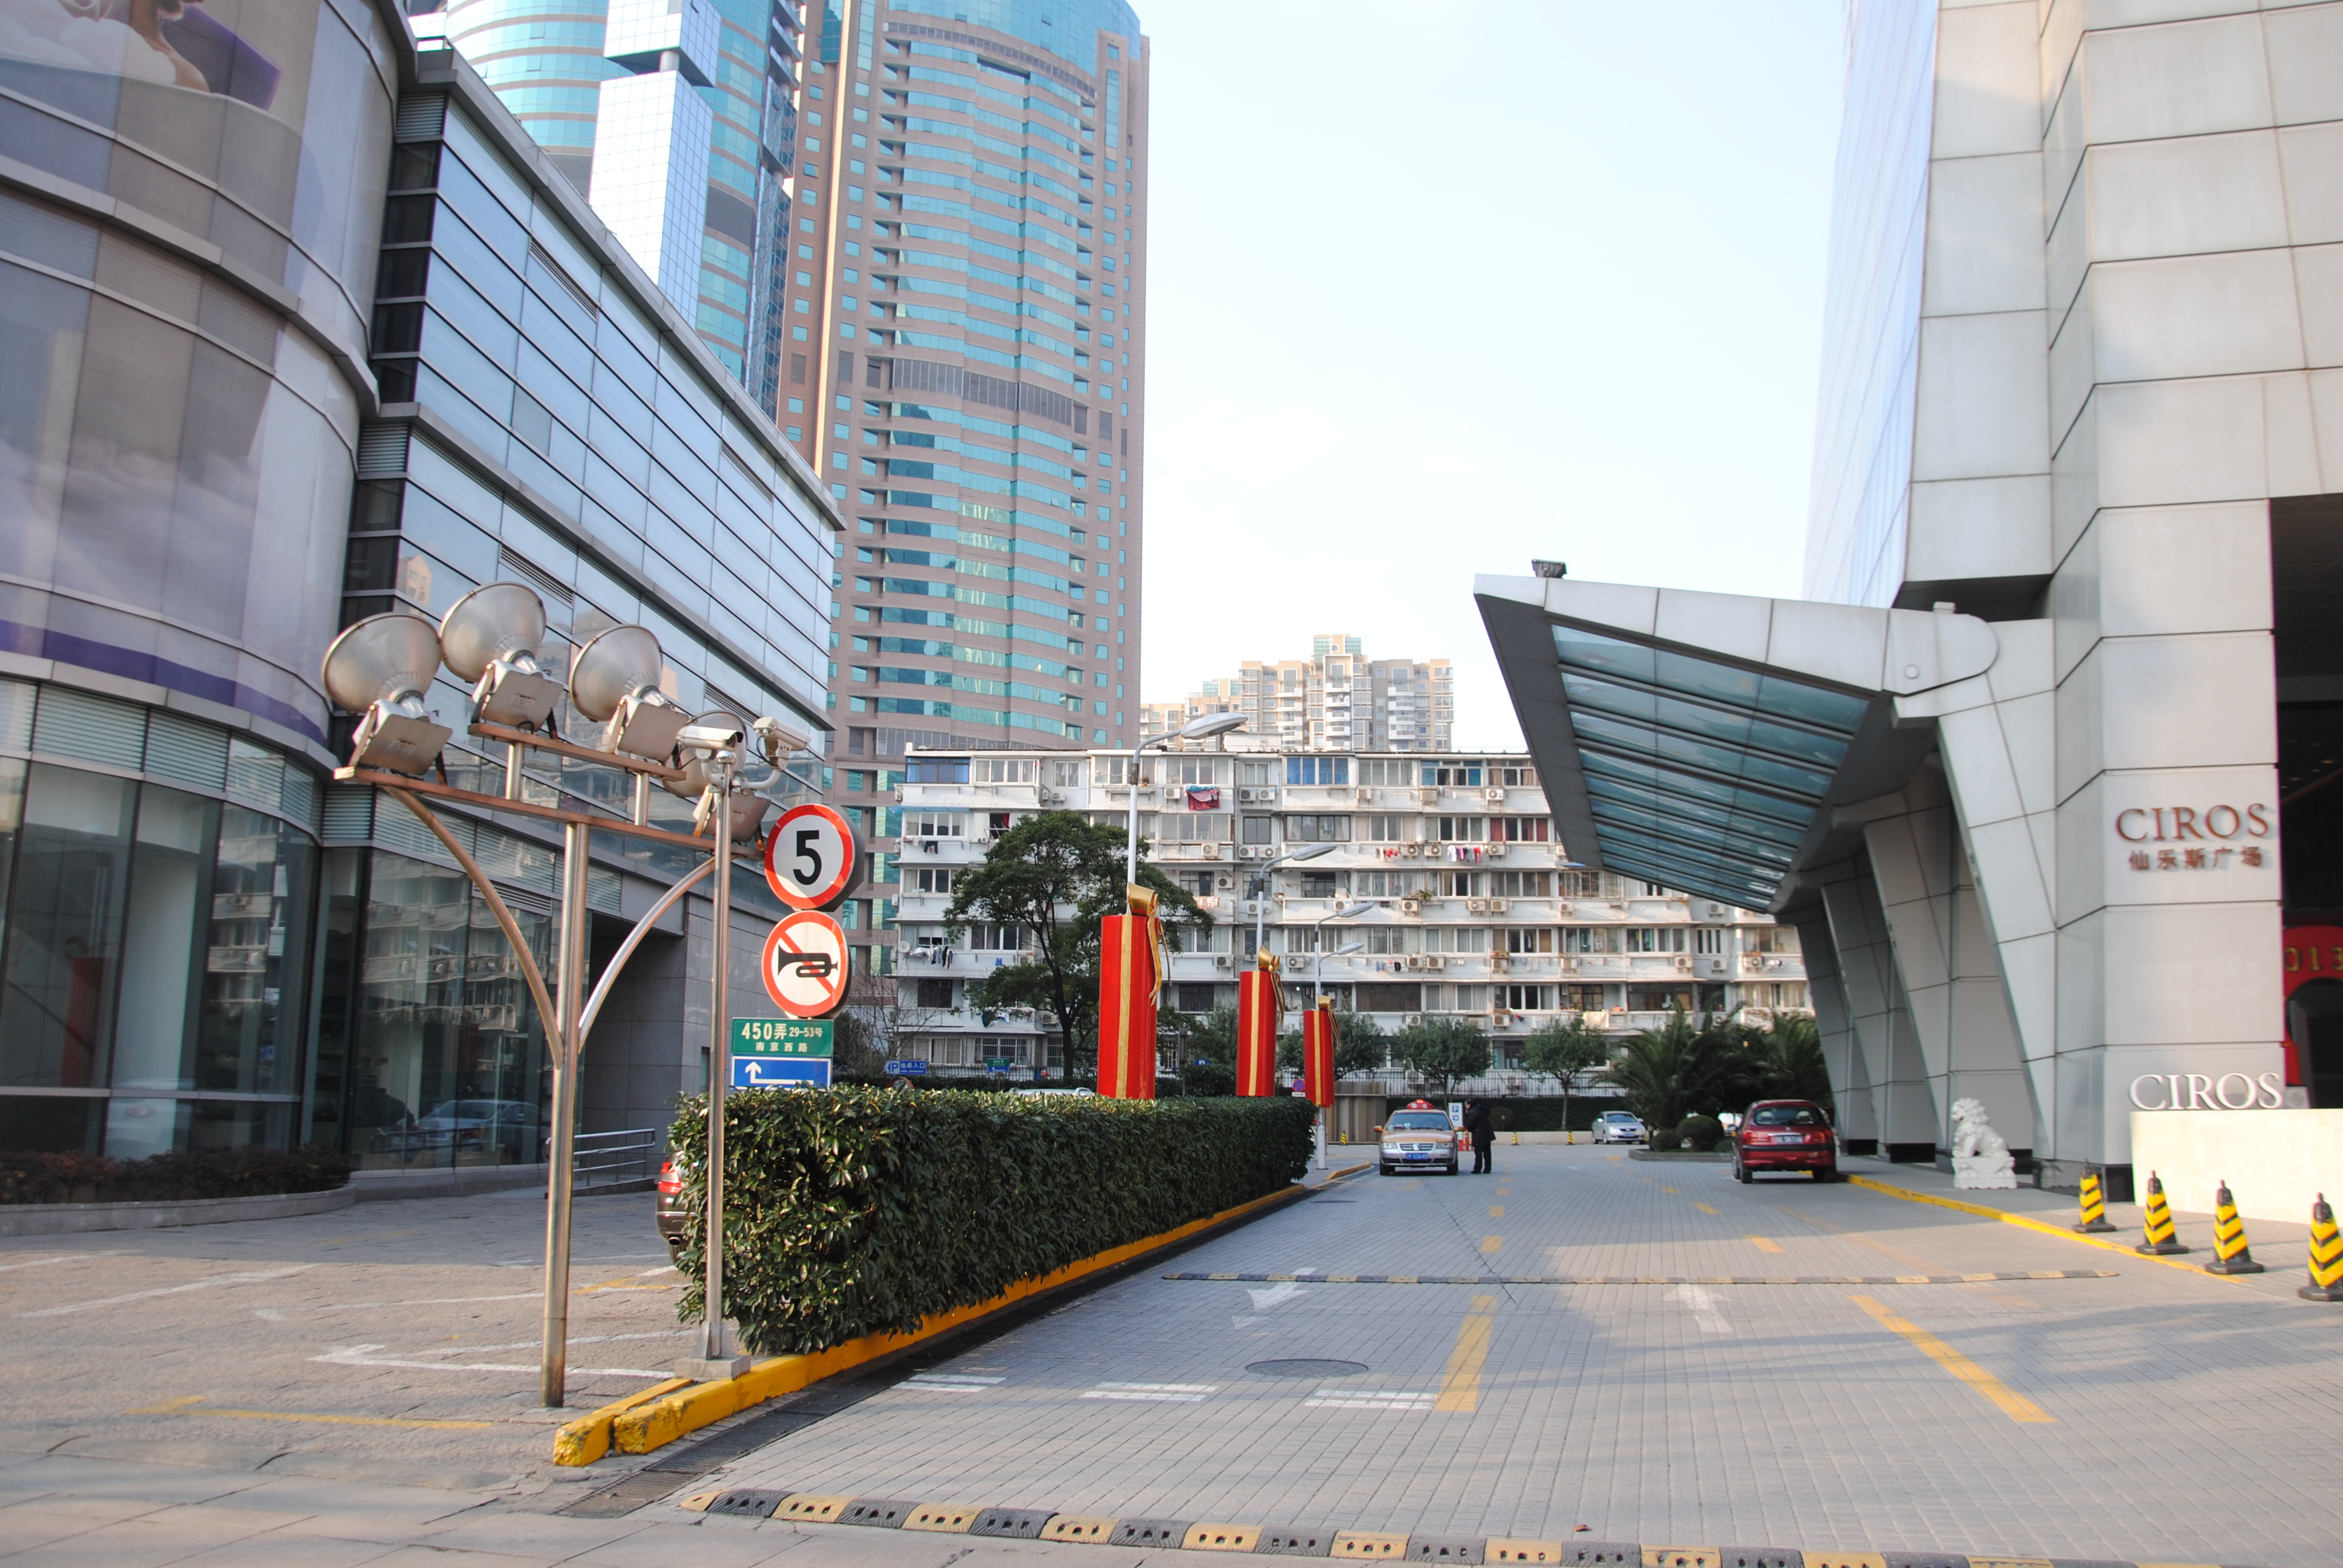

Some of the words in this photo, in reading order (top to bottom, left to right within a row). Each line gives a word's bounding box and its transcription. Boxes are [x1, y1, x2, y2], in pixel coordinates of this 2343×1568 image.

[2116, 803, 2268, 841] CIROS
[793, 830, 822, 885] 5
[2129, 847, 2262, 870] 仙乐斯广场
[741, 1022, 787, 1040] 450弄
[755, 1042, 808, 1052] 南京西路
[891, 1063, 899, 1072] P
[2129, 1073, 2282, 1110] CIROS
